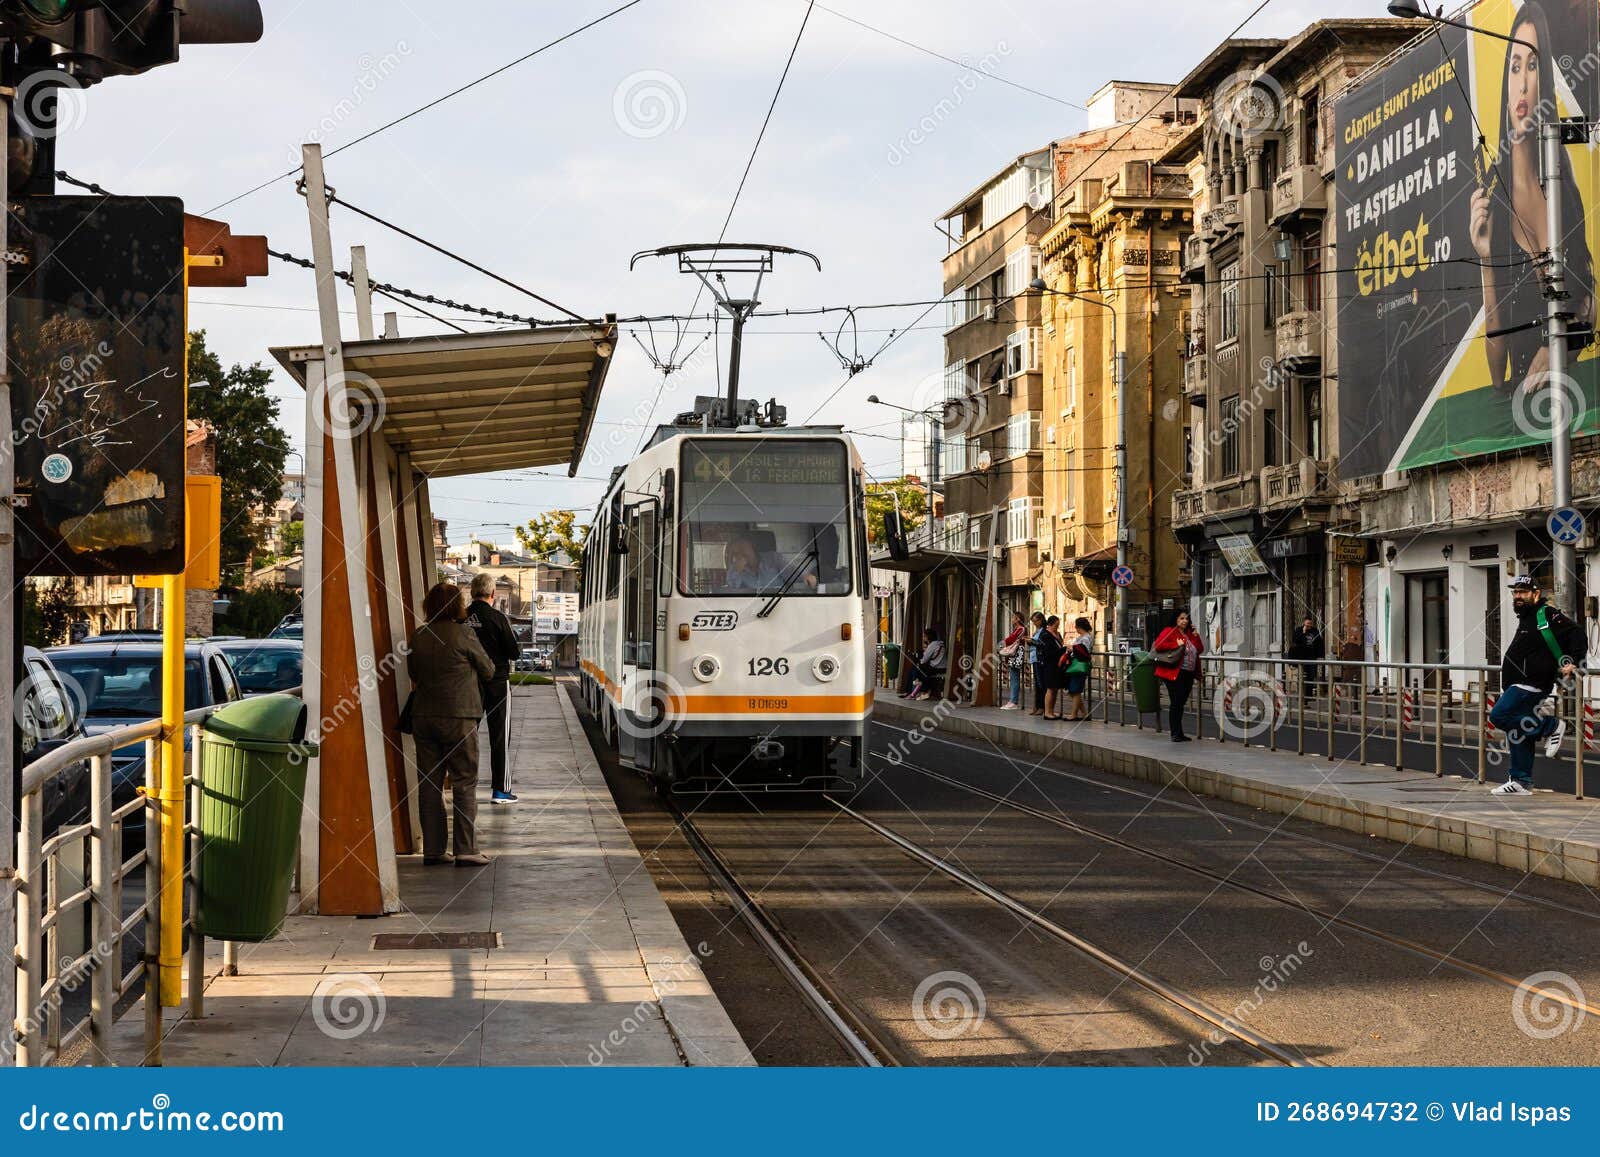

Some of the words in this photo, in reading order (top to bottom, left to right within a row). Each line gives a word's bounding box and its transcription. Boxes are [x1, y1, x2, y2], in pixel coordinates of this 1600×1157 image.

[1383, 88, 1410, 120] SUNT
[1357, 108, 1440, 183] DANIELA
[1346, 203, 1361, 232] TE
[1437, 150, 1456, 185] PE
[694, 453, 732, 482] 44
[747, 657, 790, 676] 126
